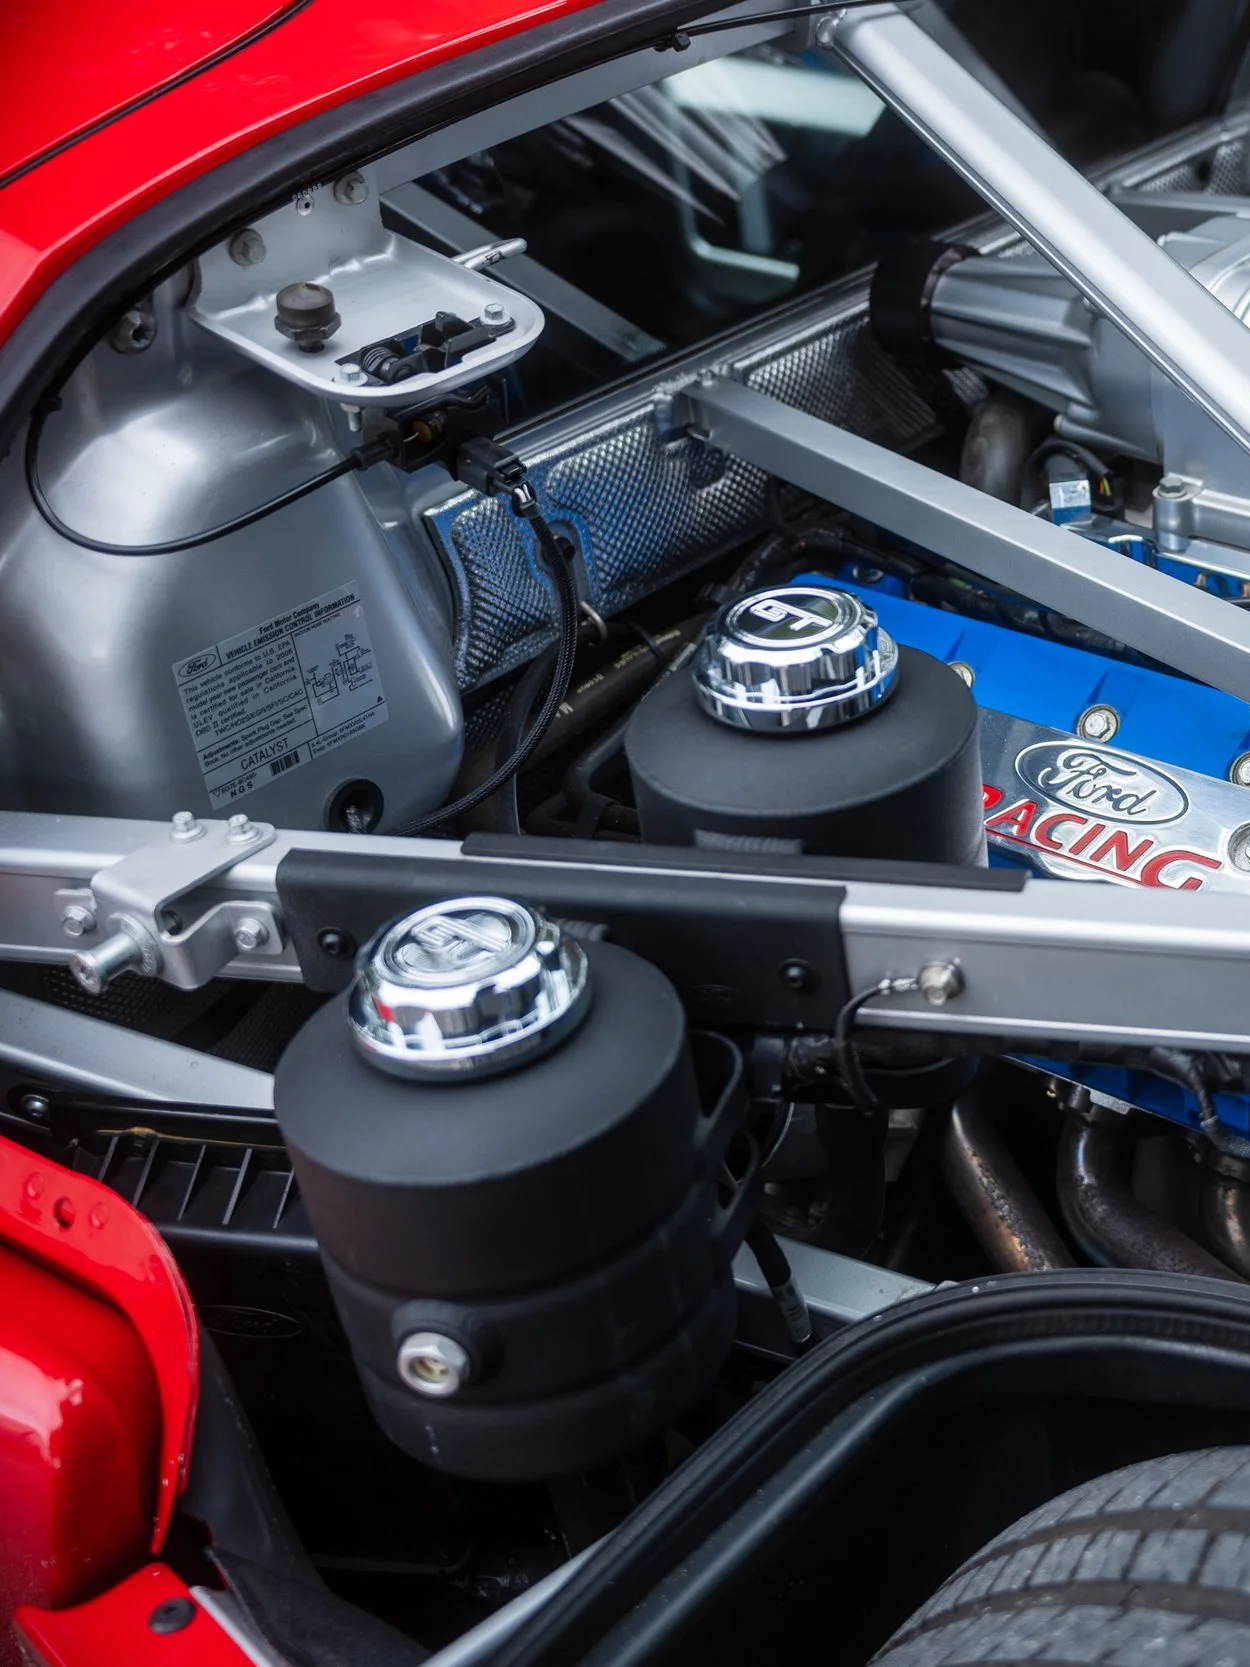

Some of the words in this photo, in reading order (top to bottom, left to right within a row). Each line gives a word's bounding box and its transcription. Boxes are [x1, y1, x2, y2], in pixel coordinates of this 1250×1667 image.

[226, 642, 253, 659] VEHICLE
[253, 627, 284, 647] EMISSION
[285, 614, 313, 632] CONTROL
[314, 593, 355, 618] INFORMATION
[259, 623, 274, 634] Ford
[274, 615, 291, 628] Motor
[292, 603, 320, 619] Company
[749, 598, 833, 631] GT
[184, 685, 198, 694] This
[200, 674, 222, 687] vehicle
[224, 659, 253, 676] conforms
[262, 647, 276, 658] U.S.
[277, 640, 291, 651] EPA
[186, 657, 210, 675] Ford
[186, 682, 225, 703] regulations
[228, 664, 263, 684] applicable
[189, 698, 208, 712] model
[209, 692, 222, 703] year
[224, 686, 236, 695] new
[237, 669, 268, 690] passenger
[269, 663, 282, 673] cars
[283, 656, 295, 666] and
[193, 714, 213, 729] ULEV
[218, 697, 249, 717] qualified
[200, 699, 227, 716] certified
[229, 694, 237, 702] for
[240, 686, 254, 696] sale
[203, 739, 240, 760] Adjustments:
[241, 730, 257, 741] Spark
[257, 724, 270, 733] Plug
[241, 737, 288, 770] CATALYST
[245, 728, 276, 747] adjustments
[1037, 750, 1158, 817] Ford
[980, 784, 1222, 890] ACING
